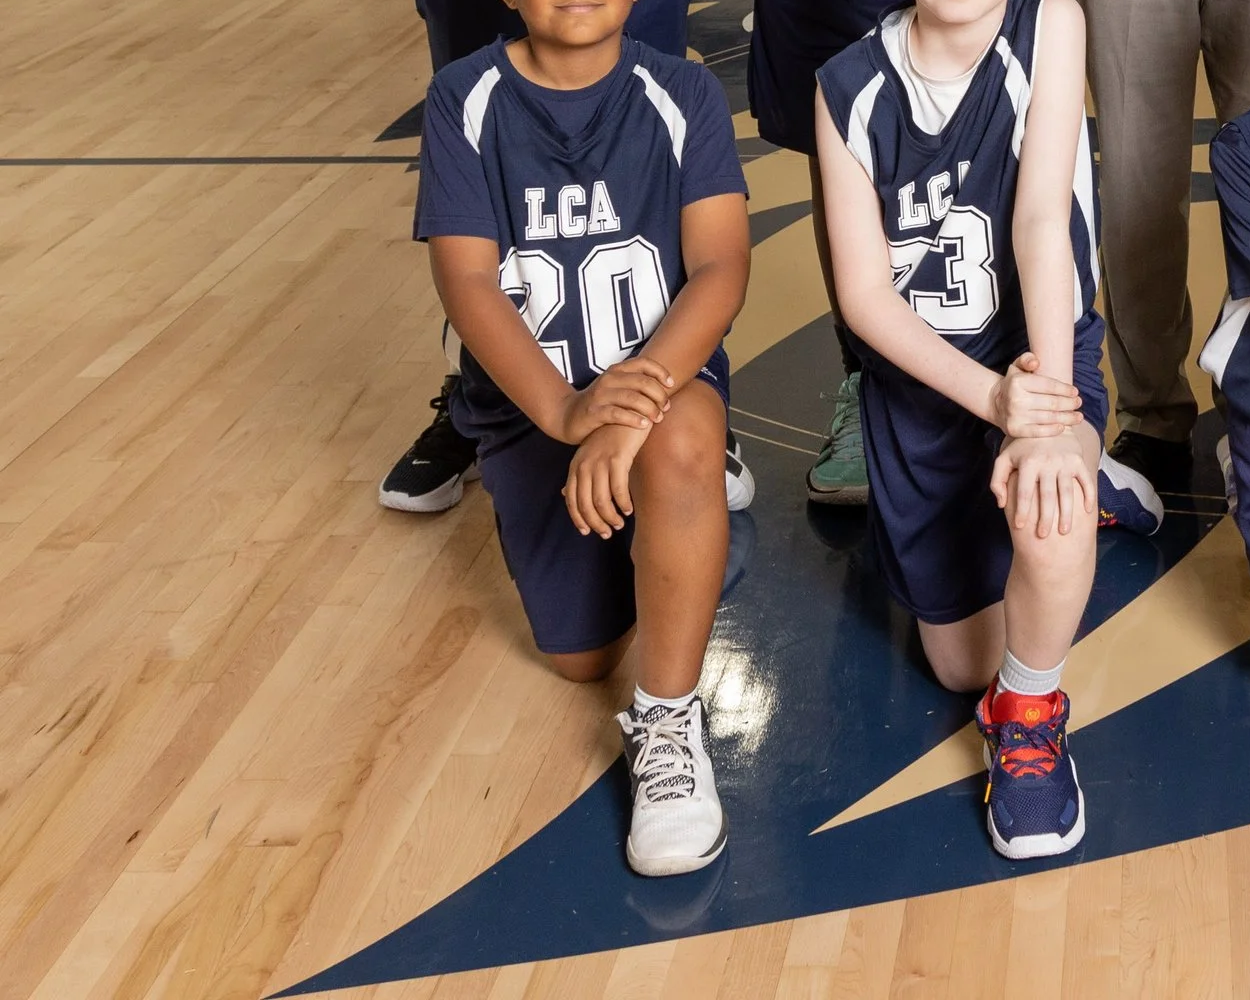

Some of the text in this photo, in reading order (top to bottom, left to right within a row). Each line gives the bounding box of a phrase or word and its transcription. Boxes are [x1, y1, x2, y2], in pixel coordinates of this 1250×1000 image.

[525, 180, 621, 241] LCA
[898, 160, 971, 231] LC
[499, 234, 670, 384] 20
